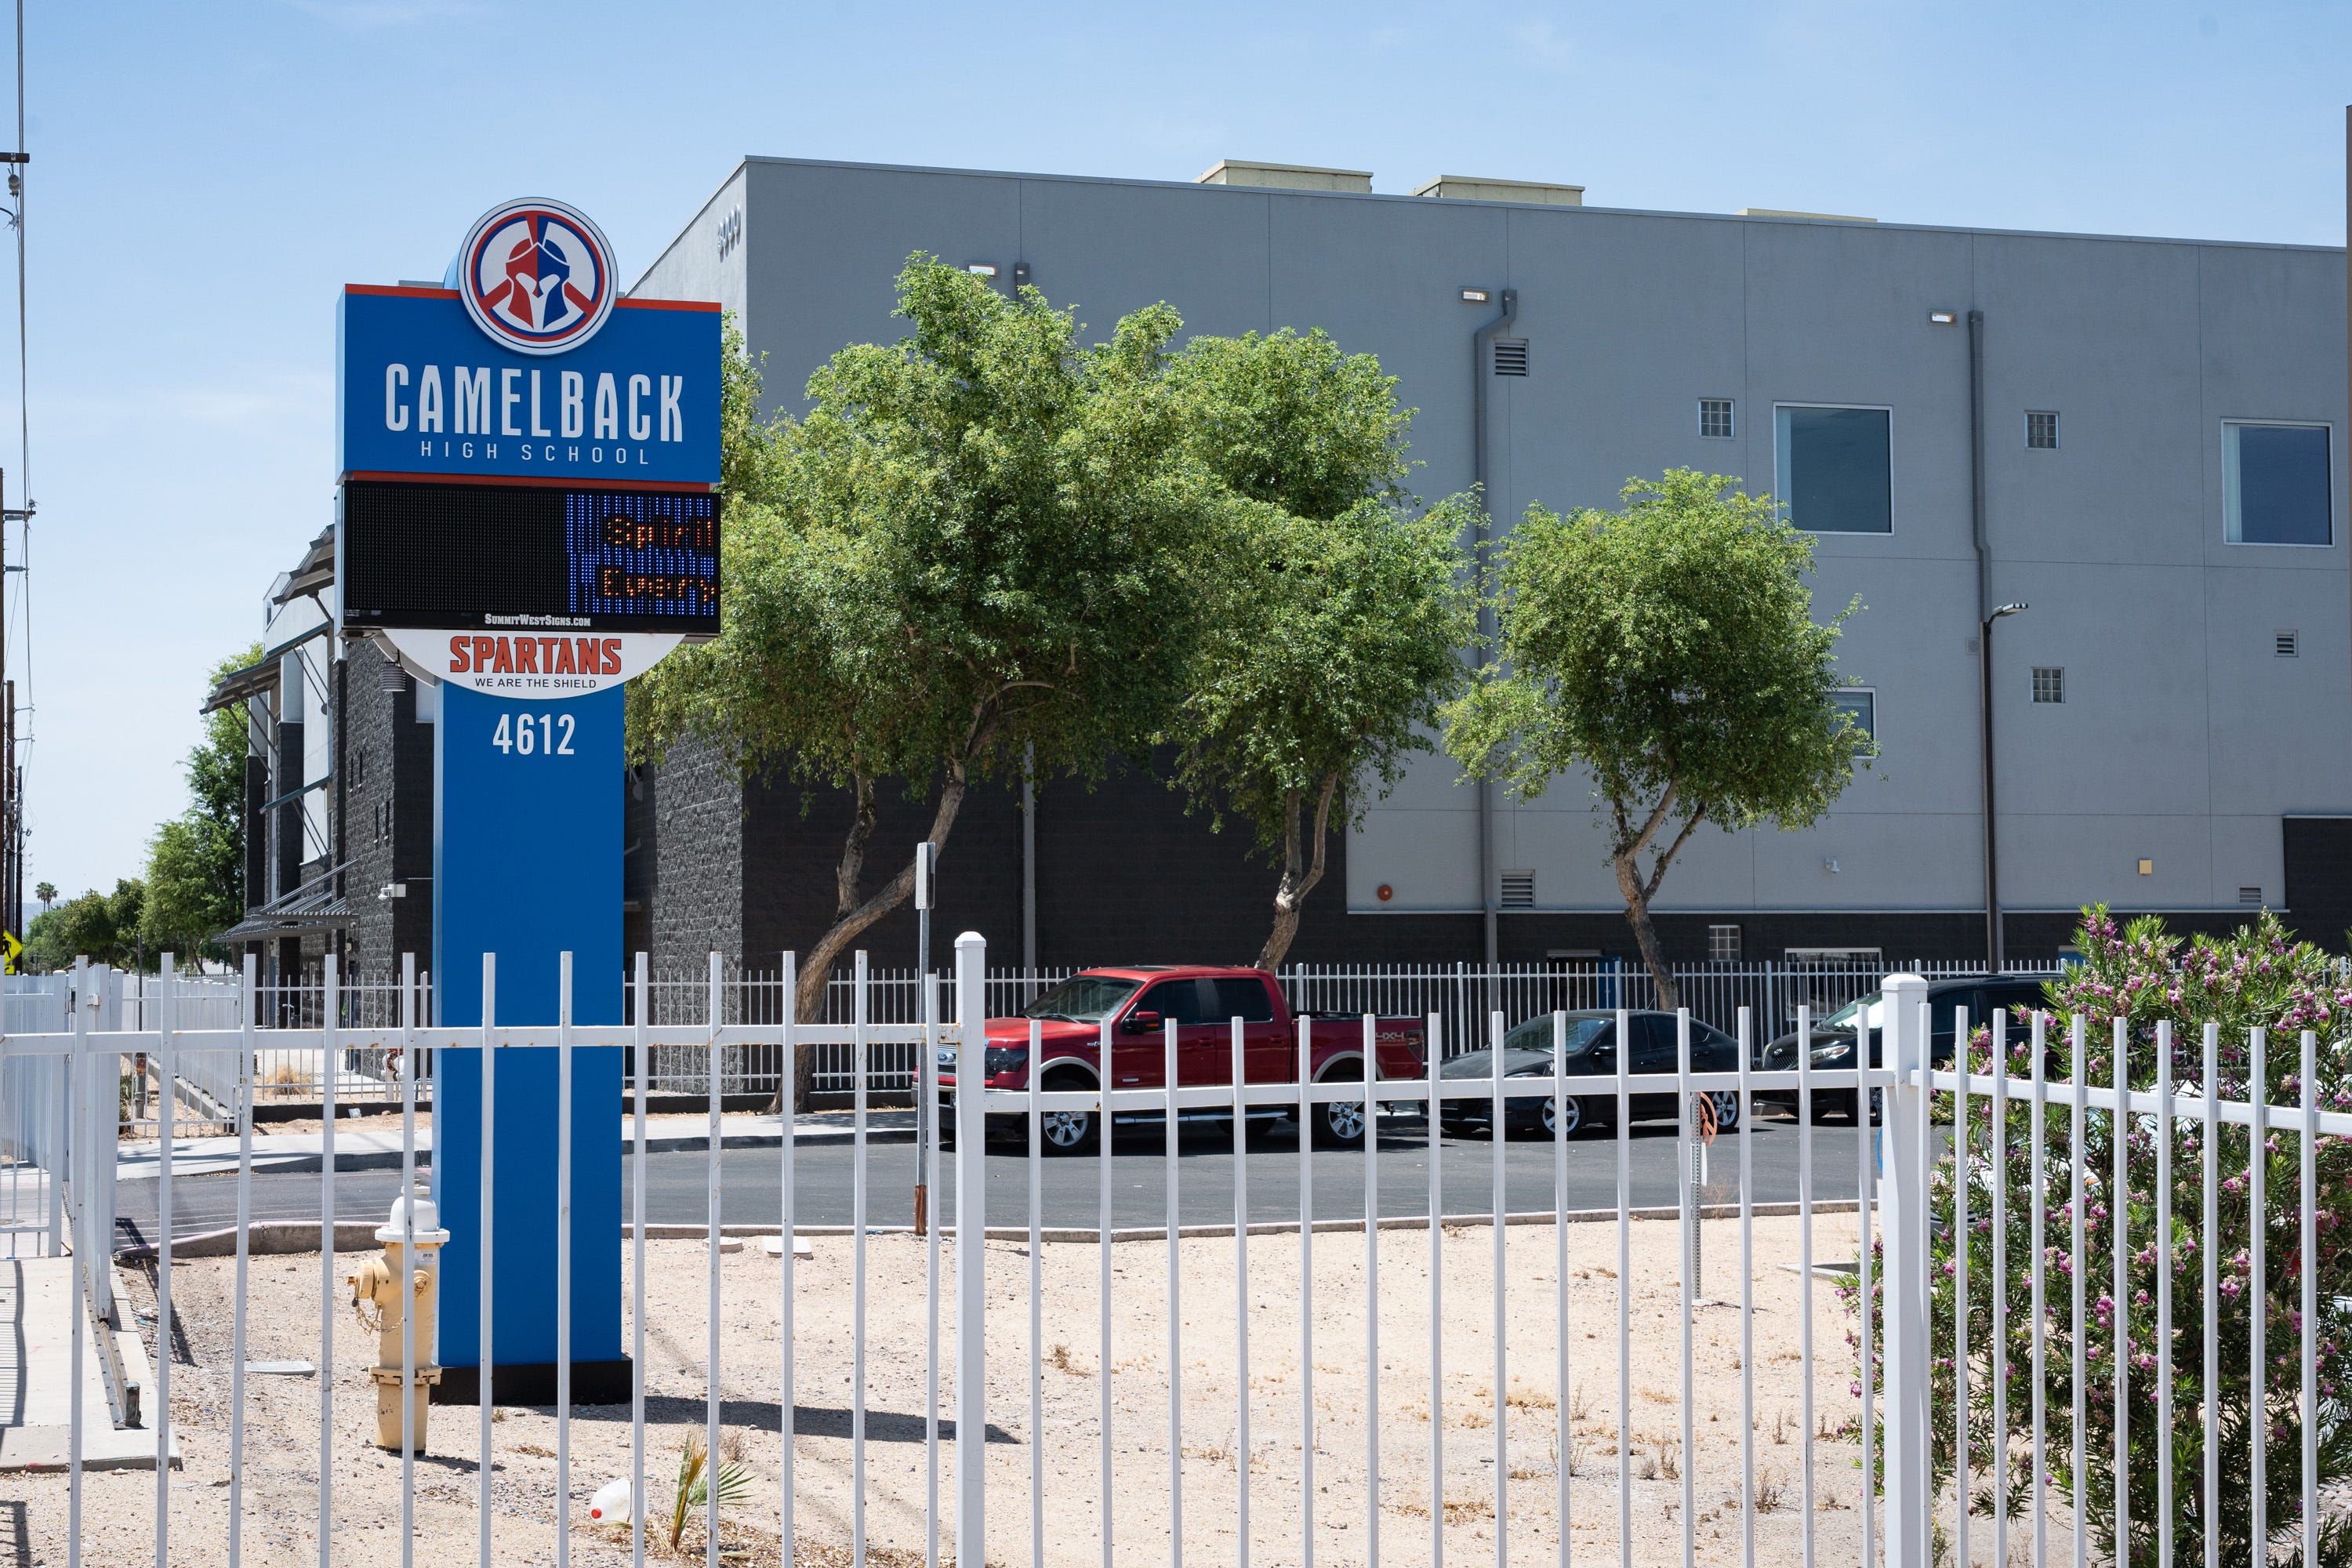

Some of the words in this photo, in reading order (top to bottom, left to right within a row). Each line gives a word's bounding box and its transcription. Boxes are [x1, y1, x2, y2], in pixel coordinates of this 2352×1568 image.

[385, 363, 684, 442] CAMELBACK
[420, 441, 498, 459] HIGH
[521, 444, 649, 465] SCHOOL
[604, 568, 716, 602] Every
[449, 636, 622, 675] SPARTANS
[474, 678, 494, 688] WE
[498, 678, 522, 688] ARE
[528, 679, 550, 688] THE
[554, 679, 597, 689] SHIELD
[492, 713, 576, 756] 4612
